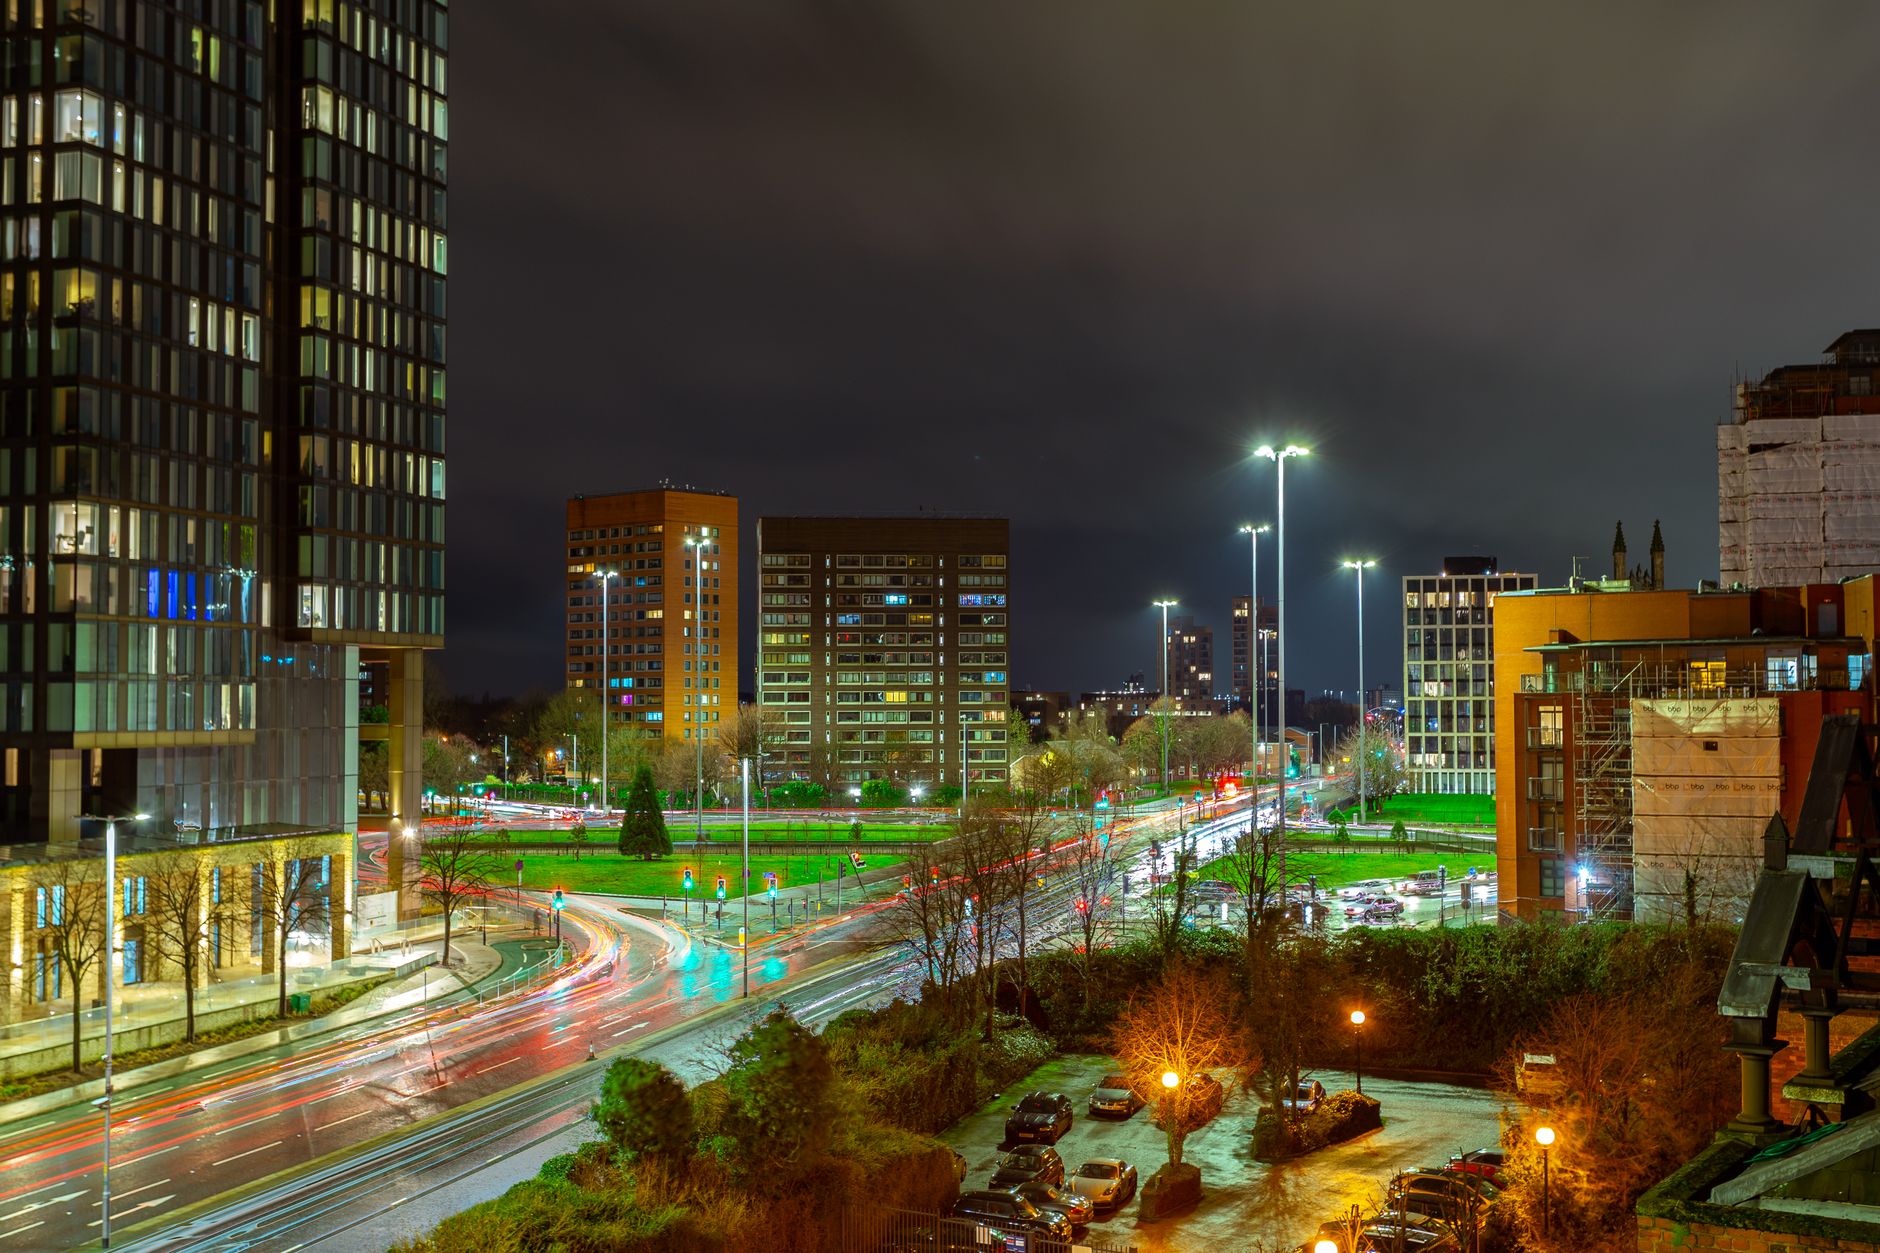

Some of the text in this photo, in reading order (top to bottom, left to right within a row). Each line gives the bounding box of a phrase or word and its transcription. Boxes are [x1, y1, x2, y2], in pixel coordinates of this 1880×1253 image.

[1643, 705, 1657, 713] bbp
[1667, 705, 1681, 713] bbp
[1693, 705, 1707, 713] bbp
[1743, 704, 1757, 712] bbp
